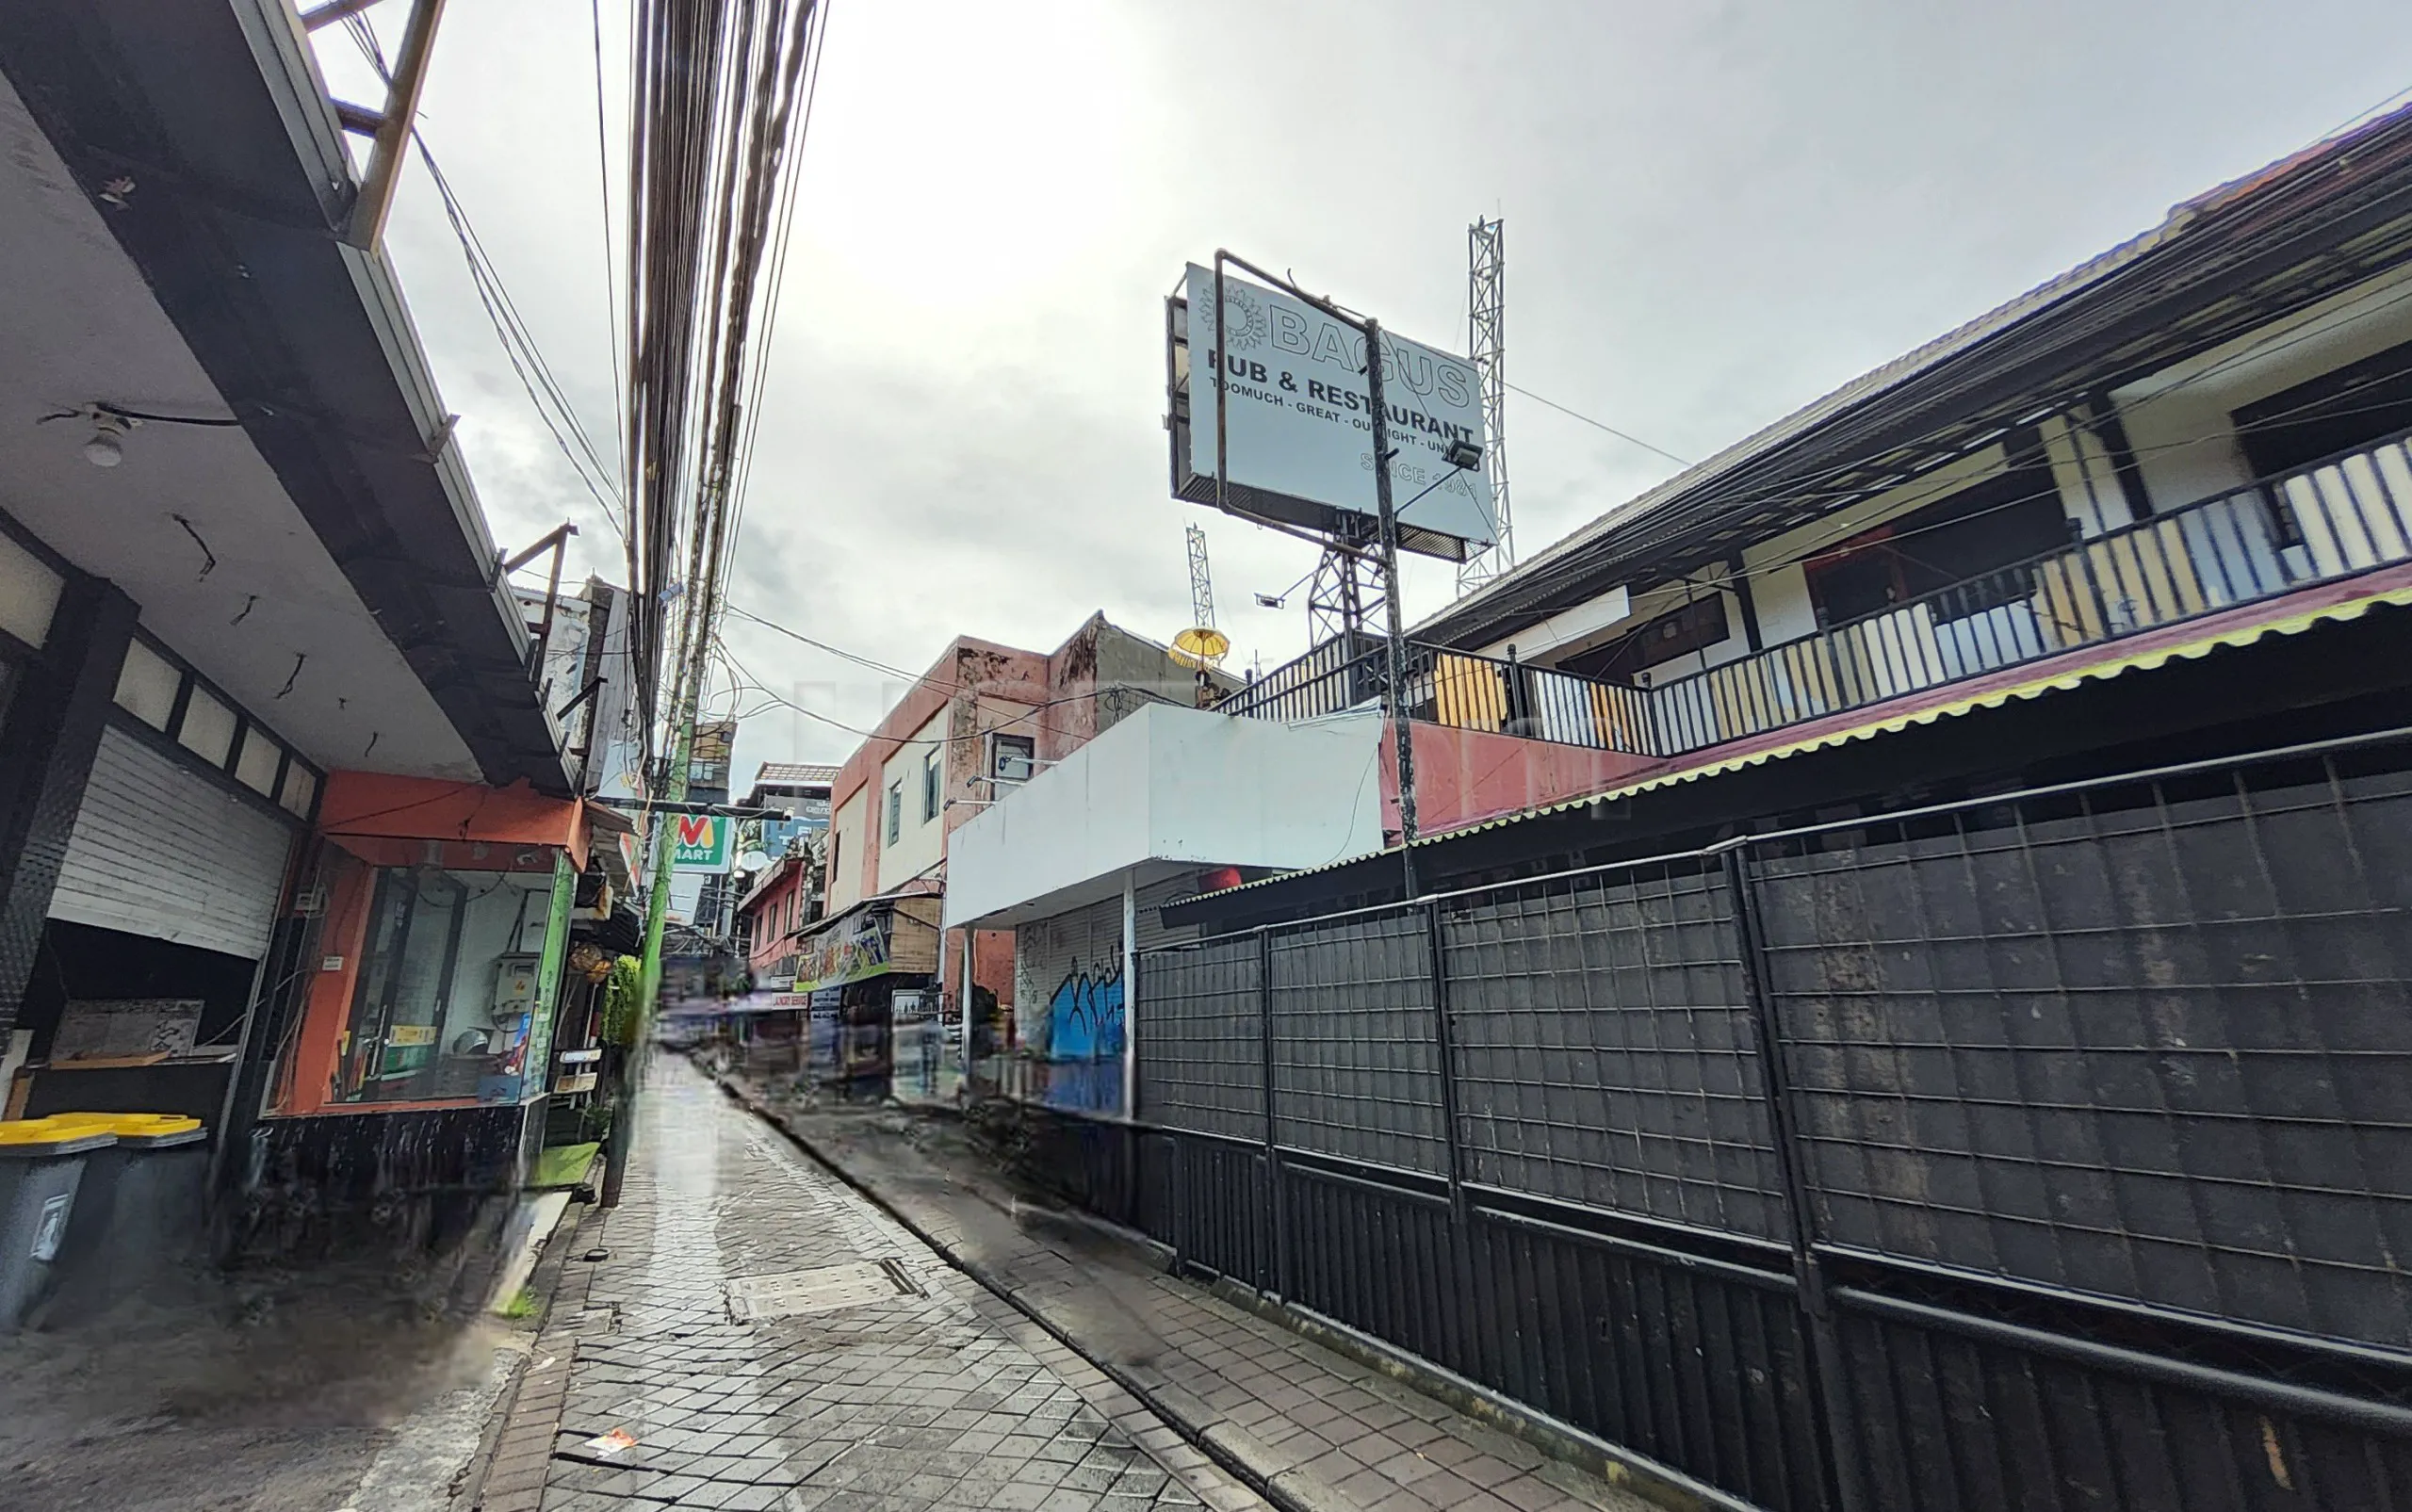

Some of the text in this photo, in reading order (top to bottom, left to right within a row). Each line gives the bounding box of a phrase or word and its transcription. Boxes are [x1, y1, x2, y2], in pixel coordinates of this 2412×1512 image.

[1269, 303, 1470, 409] BAGUS
[1279, 370, 1298, 394] &
[1296, 401, 1342, 424] GREAT
[1352, 417, 1417, 446] OUIGHT
[1360, 452, 1426, 485] SCE
